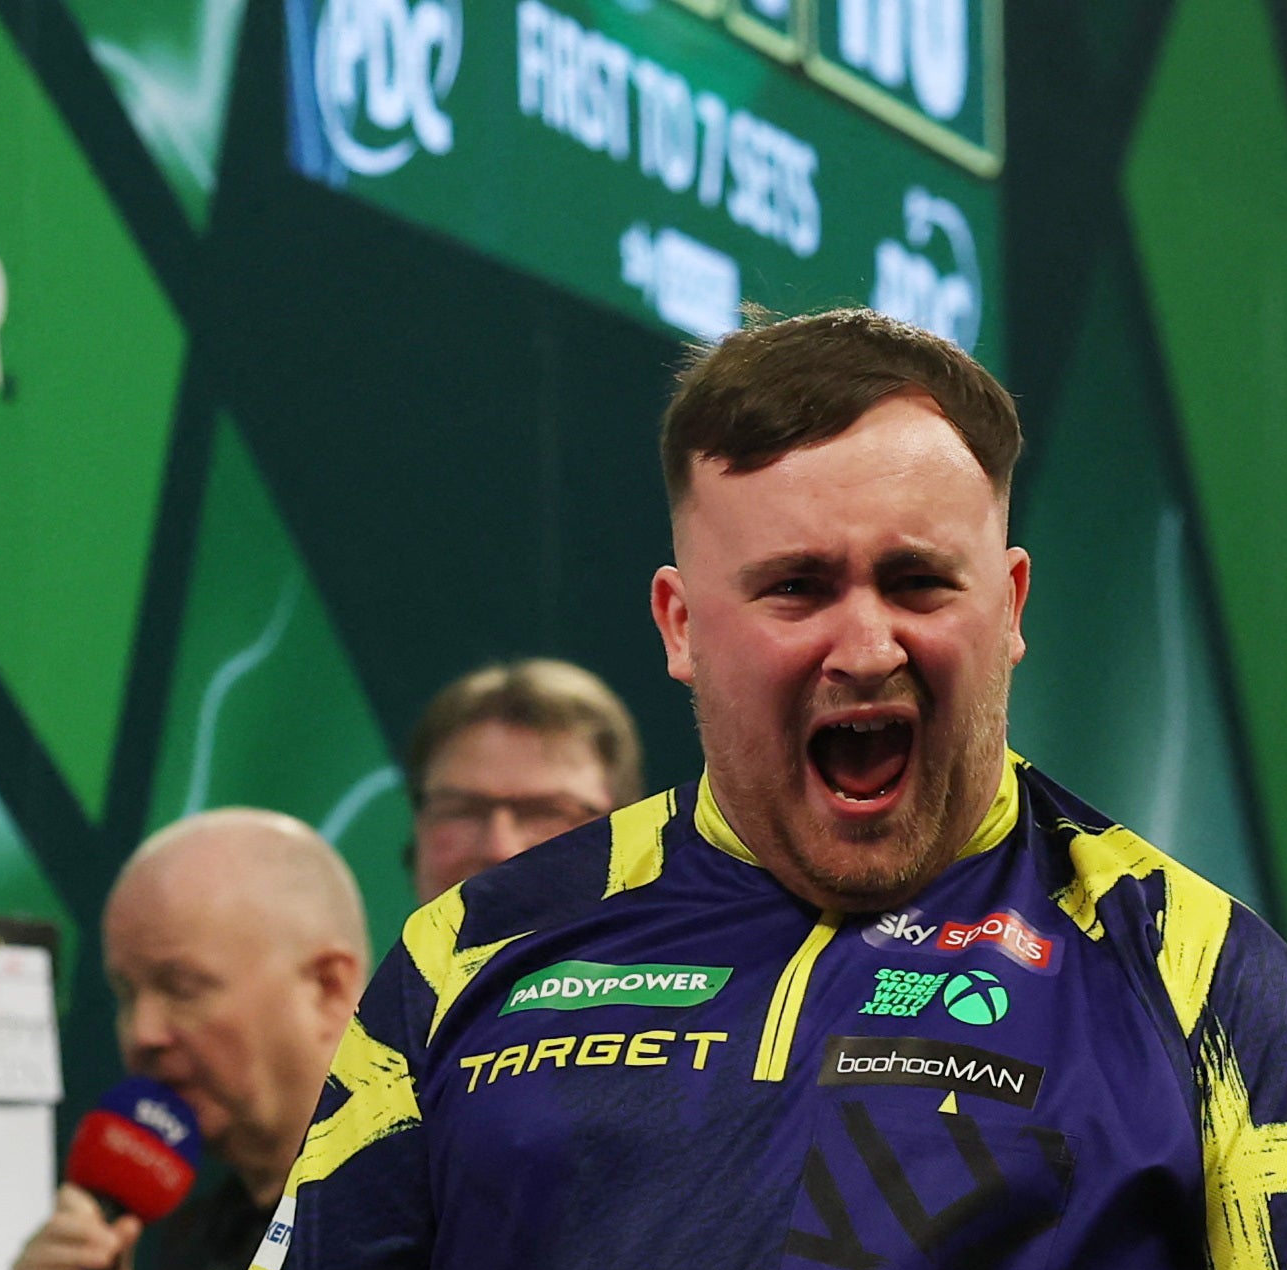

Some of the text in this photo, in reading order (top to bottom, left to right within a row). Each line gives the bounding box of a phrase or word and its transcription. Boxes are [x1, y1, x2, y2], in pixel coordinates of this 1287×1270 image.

[517, 0, 630, 161] FIRST
[633, 57, 698, 192] TO
[725, 110, 822, 258] SETS
[876, 913, 1044, 961] sky sports
[875, 968, 949, 985] SCORE
[876, 980, 941, 995] MORE
[858, 1002, 922, 1017] XBOX
[872, 990, 933, 1007] WITH
[459, 1030, 729, 1094] TARGET
[836, 1050, 1026, 1094] boohooMAN
